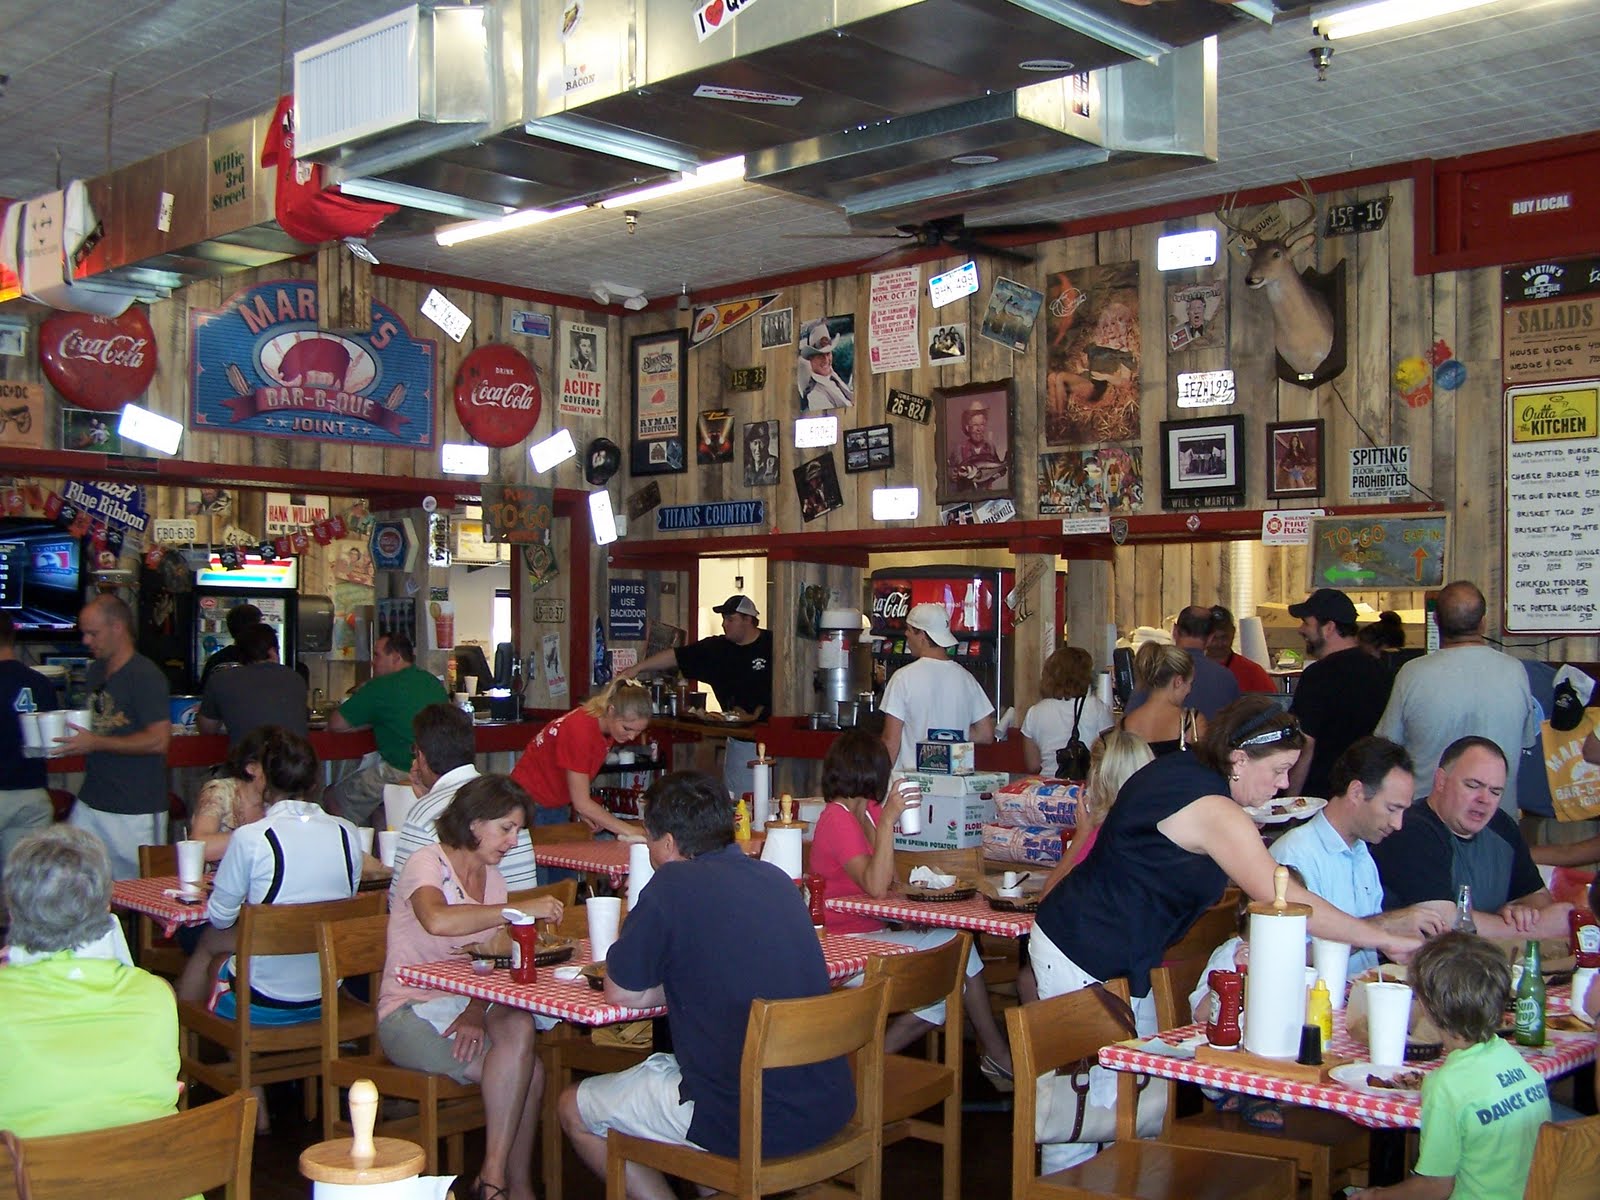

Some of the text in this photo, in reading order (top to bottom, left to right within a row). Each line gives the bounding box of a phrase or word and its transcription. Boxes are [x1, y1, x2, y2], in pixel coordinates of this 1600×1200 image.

[565, 74, 596, 91] BACON
[213, 151, 245, 175] Willie
[225, 167, 245, 188] 3rd
[212, 187, 246, 211] Street
[1512, 195, 1570, 216] BUY LOCAL
[1522, 264, 1564, 281] MARTIN'S
[872, 289, 917, 303] MON. OCT. 17
[1517, 302, 1593, 334] SALADS
[571, 324, 595, 333] ELECT
[1509, 343, 1582, 357] HOUSE WEDGE
[495, 366, 515, 376] DRINK
[1510, 360, 1543, 371] WEDGE
[1553, 358, 1574, 366] QUE
[563, 378, 602, 398] ACUFF
[265, 387, 375, 418] BAR-B-QUE
[563, 394, 600, 407] GOVERNOR
[580, 405, 596, 415] NOV
[1522, 404, 1557, 423] Outta
[292, 416, 346, 435] JOINT
[640, 415, 677, 427] RYMAN
[1531, 416, 1587, 436] KITCHEN
[639, 424, 677, 434] AUDITORIUM
[1352, 447, 1408, 466] SPITTING
[1567, 447, 1600, 456] BURGER
[1352, 467, 1375, 475] FLOOR
[1511, 470, 1580, 481] CHEESE BURGER
[1352, 473, 1408, 489] PROHIBITED
[1171, 499, 1190, 508] WILL
[1204, 495, 1235, 507] MARTIN
[1511, 493, 1527, 501] THE
[1547, 490, 1581, 499] BURGER
[65, 481, 146, 531] Blue Ribbon
[1516, 508, 1575, 518] BRISKET TACO
[268, 505, 326, 524] HANK WILLIAMS
[489, 503, 551, 529] TO-GO
[664, 501, 757, 528] TITANS COUNTRY
[1323, 523, 1386, 550] TO-GO
[1514, 526, 1548, 534] BRISKET
[611, 585, 646, 595] HIPPIES
[1515, 579, 1589, 588] CHICKEN TENDER
[620, 598, 636, 607] USE
[1513, 604, 1526, 612] THE
[1530, 604, 1558, 612] PORTER
[610, 609, 647, 618] BACKDOOR
[14, 687, 38, 713] 4
[908, 839, 929, 848] SPRING
[929, 841, 958, 850] POTATOES
[1496, 1067, 1527, 1088] Eakin
[1475, 1090, 1527, 1126] DANCE
